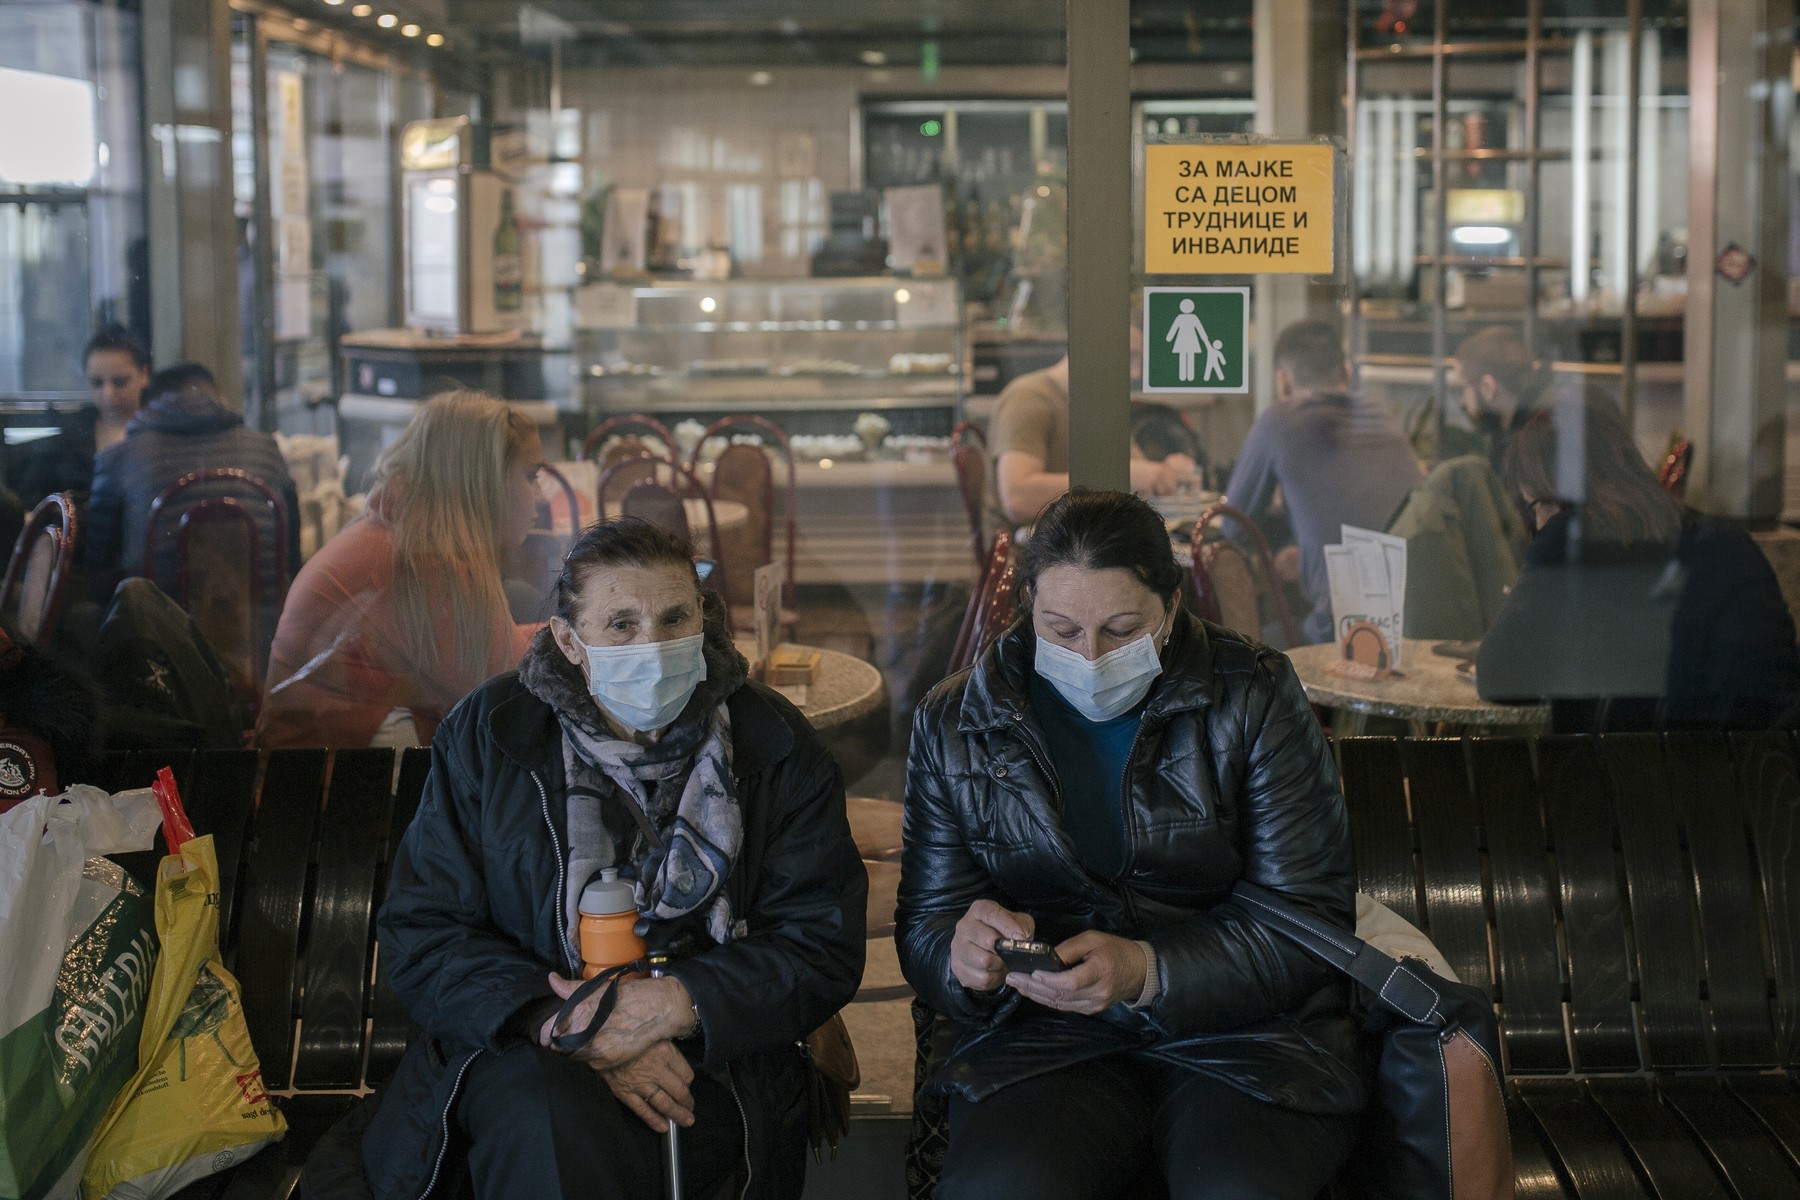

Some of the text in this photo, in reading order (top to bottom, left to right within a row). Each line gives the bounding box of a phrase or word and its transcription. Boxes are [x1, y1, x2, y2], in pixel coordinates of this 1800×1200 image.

[1178, 160, 1294, 178] ЗА МАЈКЕ
[1175, 186, 1297, 206] СА ДЕЦОМ
[1163, 211, 1309, 232] ТРУДНИЦЕ И
[1172, 237, 1300, 258] ИНВАЛИДЕ
[28, 761, 36, 779] JPN
[20, 784, 30, 793] CO
[241, 1109, 259, 1120] sagt
